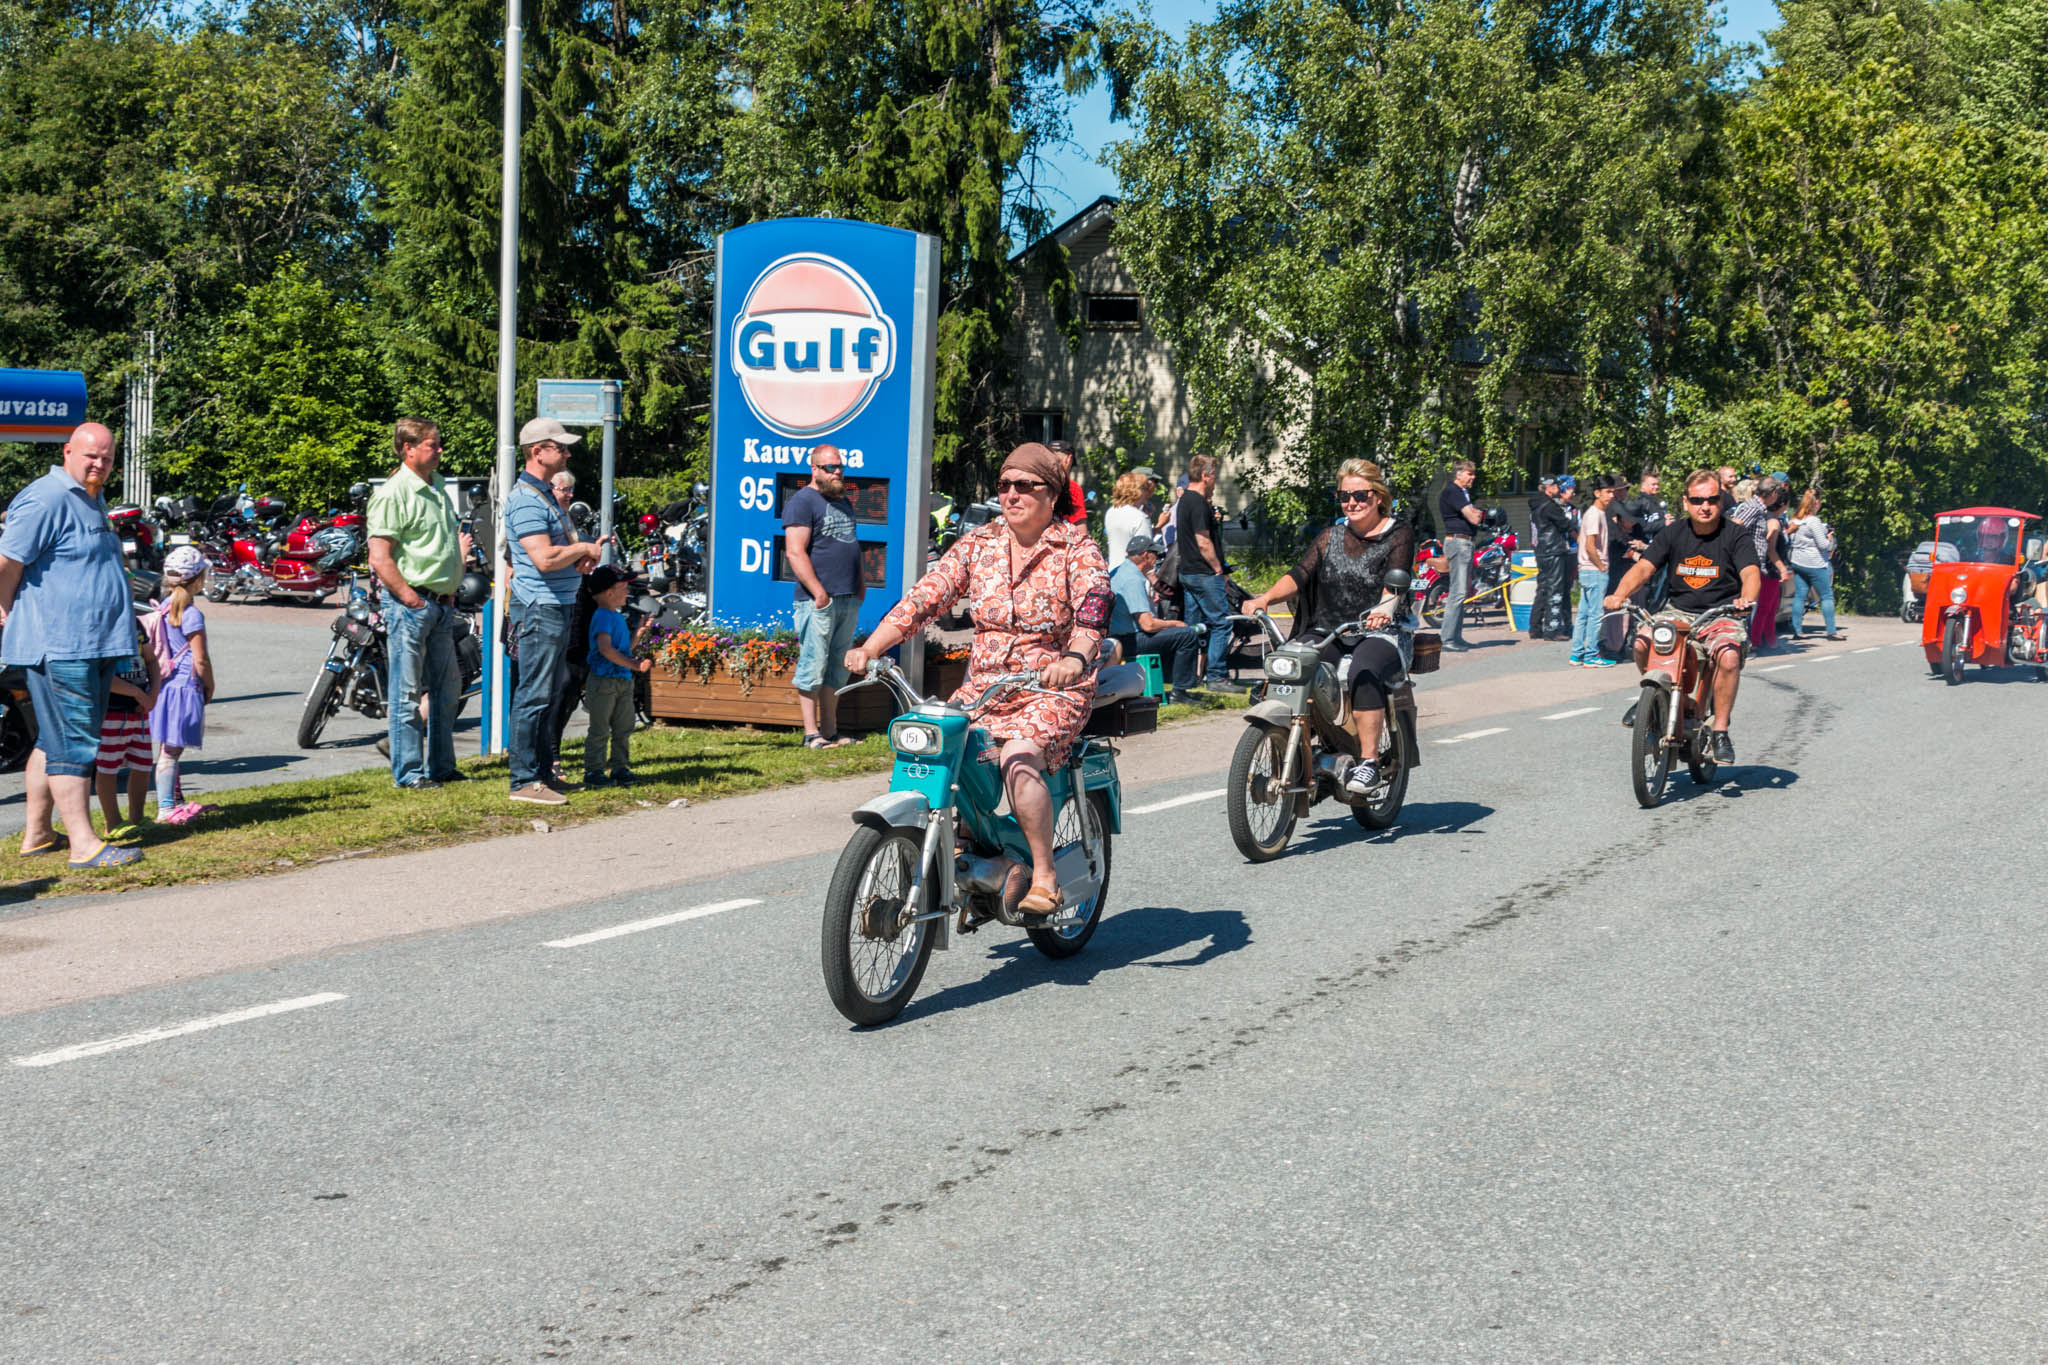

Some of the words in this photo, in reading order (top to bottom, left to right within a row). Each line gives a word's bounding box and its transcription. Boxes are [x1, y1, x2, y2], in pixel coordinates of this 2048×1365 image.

[739, 320, 881, 372] Gulf
[0, 399, 69, 416] uvatsa
[743, 438, 865, 468] Kauvsa
[739, 475, 774, 511] 95
[740, 538, 771, 574] Di
[906, 732, 919, 744] 151
